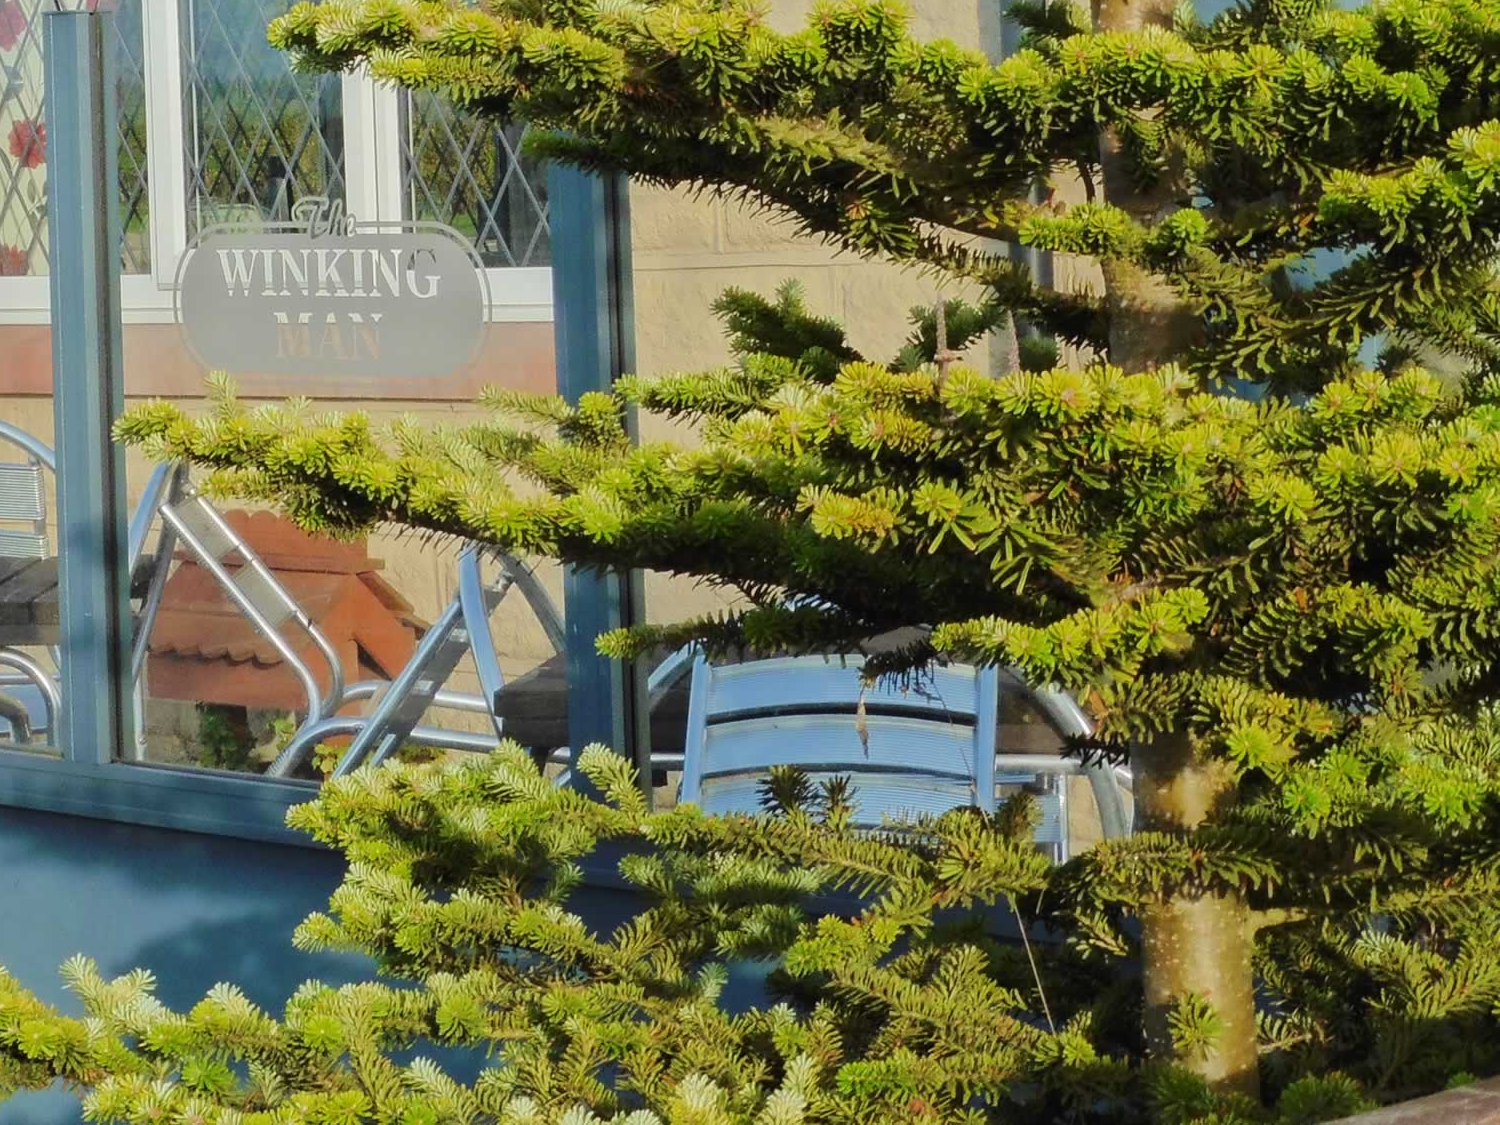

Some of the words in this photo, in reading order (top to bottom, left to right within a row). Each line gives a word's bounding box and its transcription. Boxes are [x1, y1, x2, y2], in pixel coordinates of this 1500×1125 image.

[291, 196, 357, 239] The
[216, 248, 442, 299] WINKING
[273, 312, 384, 361] MAN
